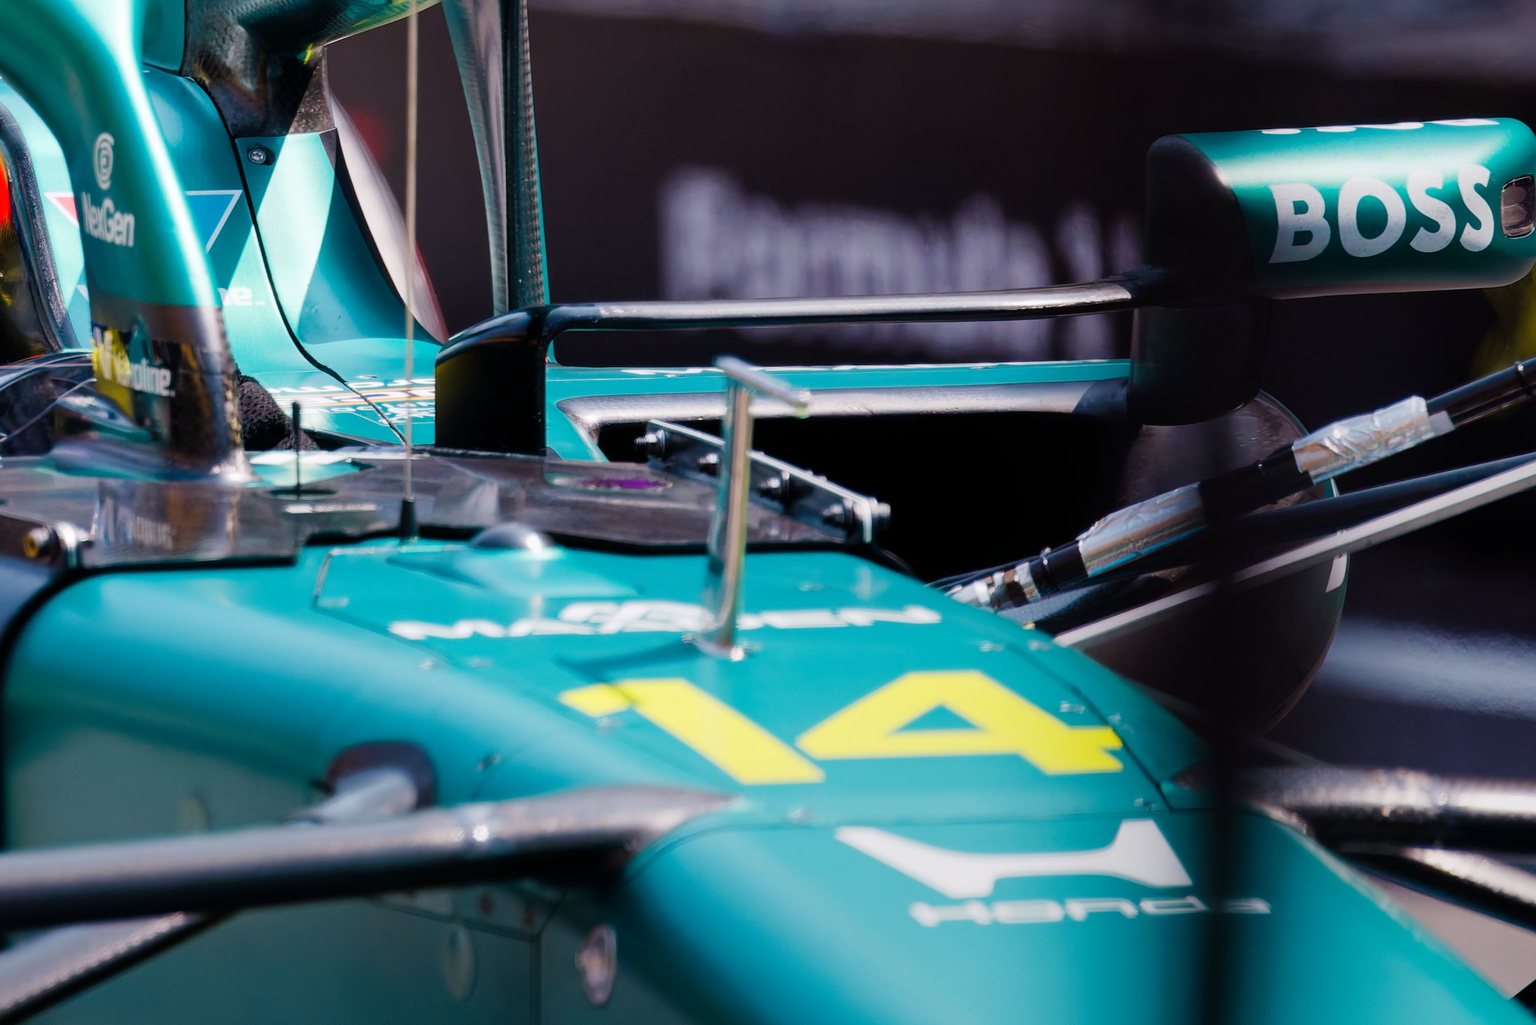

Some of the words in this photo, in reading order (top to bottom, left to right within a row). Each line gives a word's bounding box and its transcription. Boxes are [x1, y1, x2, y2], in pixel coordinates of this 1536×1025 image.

[81, 191, 135, 248] NexGen
[1268, 163, 1495, 264] BOSS
[558, 669, 1124, 786] 14
